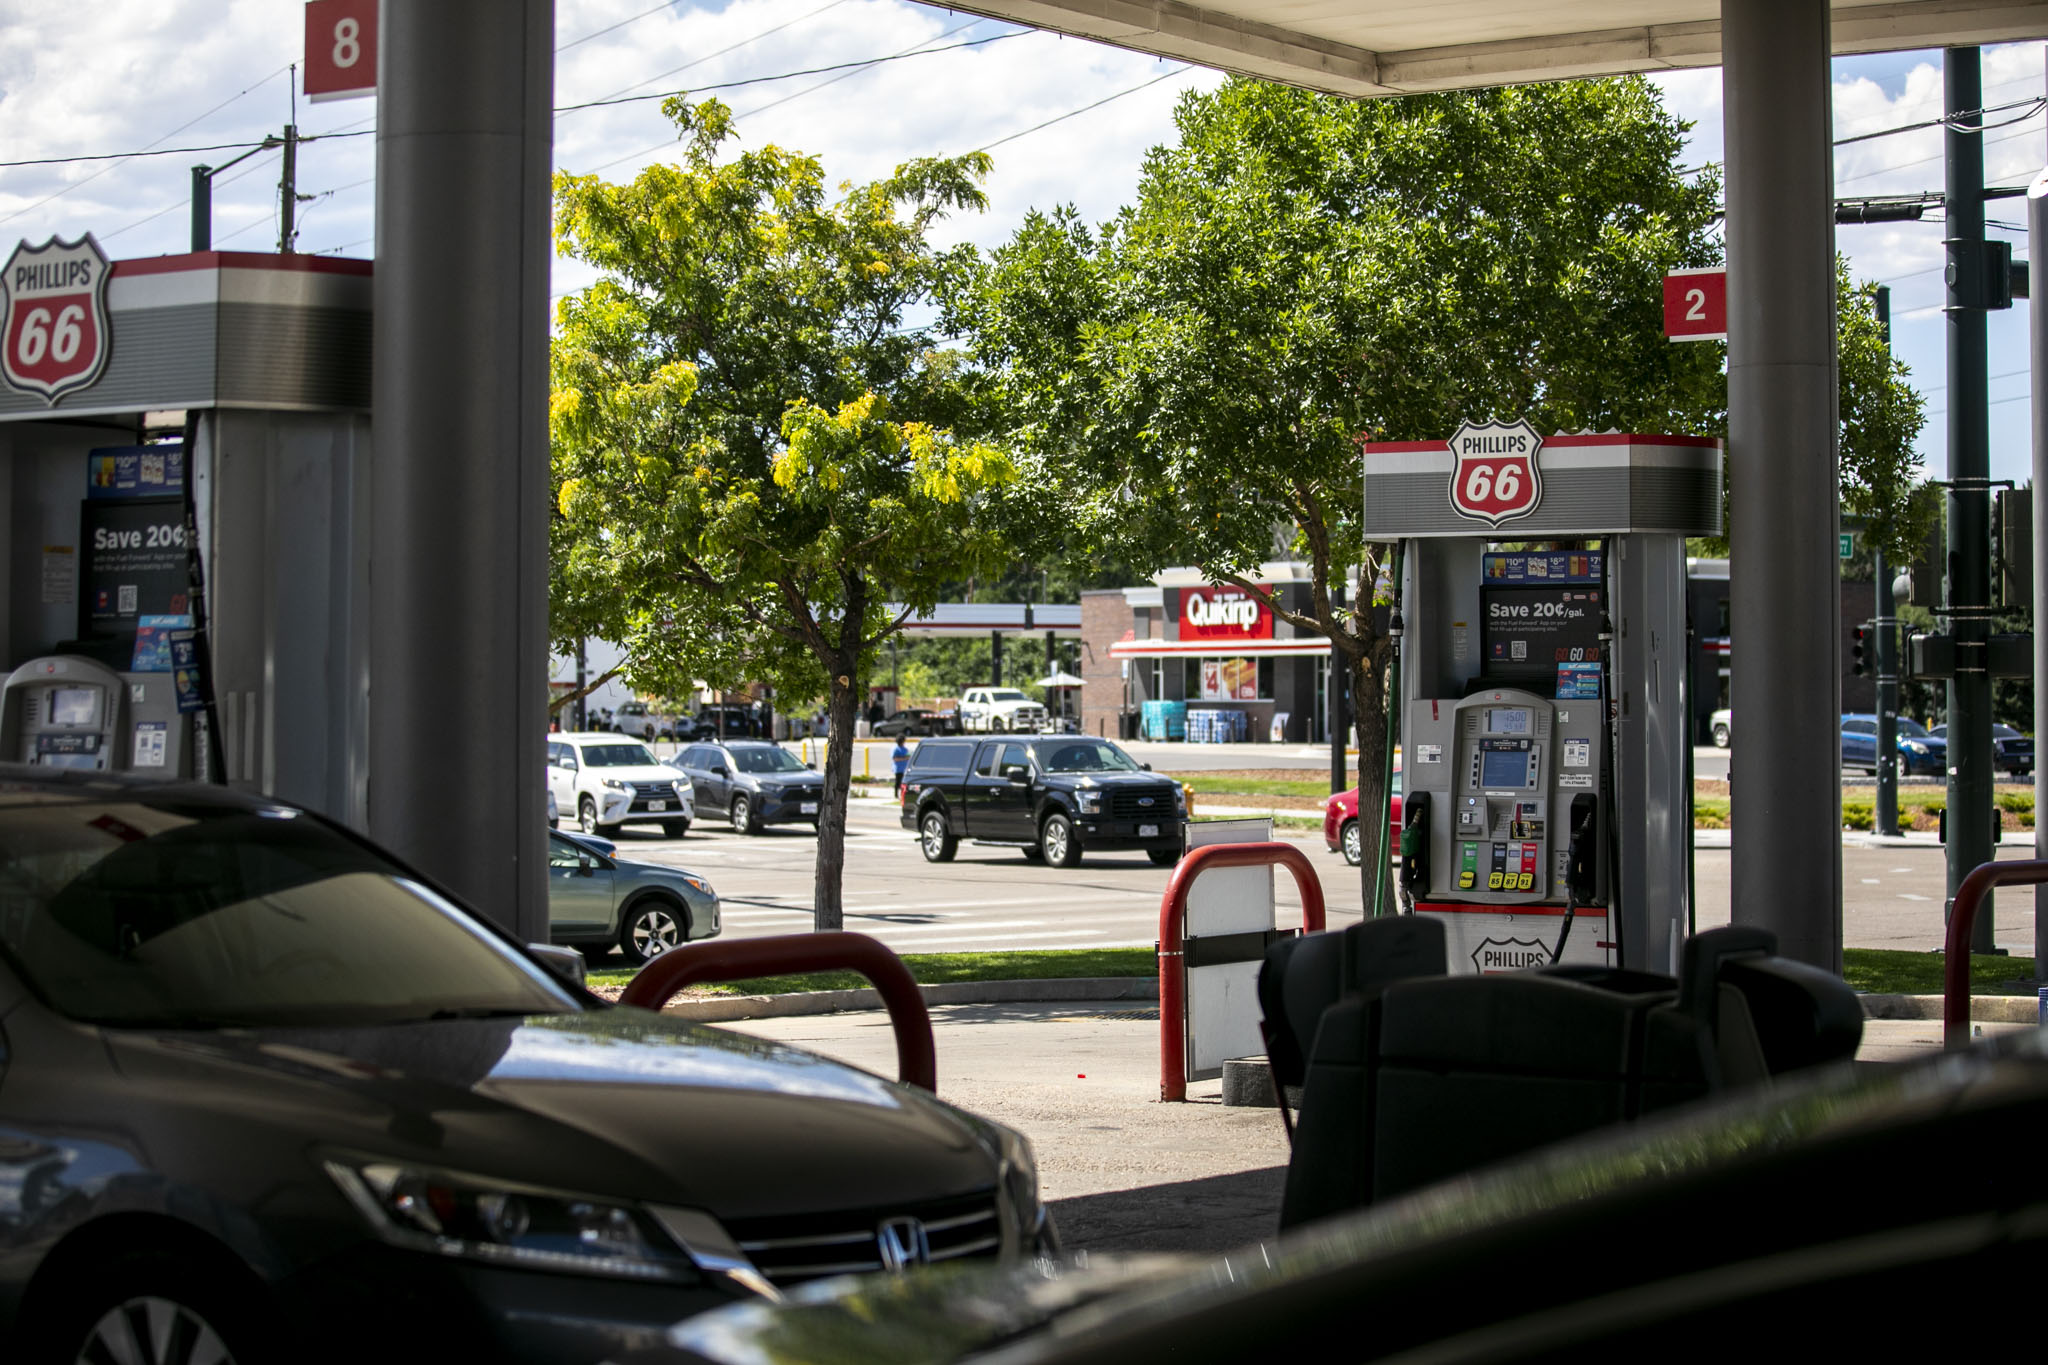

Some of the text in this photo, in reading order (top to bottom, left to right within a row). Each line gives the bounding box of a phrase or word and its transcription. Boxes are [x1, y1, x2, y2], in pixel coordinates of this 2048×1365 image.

[332, 17, 360, 69] 8
[16, 259, 91, 292] PHILLIPS
[1685, 288, 1706, 321] 2
[18, 303, 86, 366] 66
[1463, 435, 1526, 454] PHILLIPS
[1466, 463, 1523, 502] 66
[94, 527, 142, 550] Save
[1186, 592, 1258, 631] QuikTrip
[1490, 602, 1529, 617] Save
[1570, 647, 1584, 661] GO
[1585, 648, 1600, 661] GO
[1484, 950, 1545, 969] PHILLIPS
